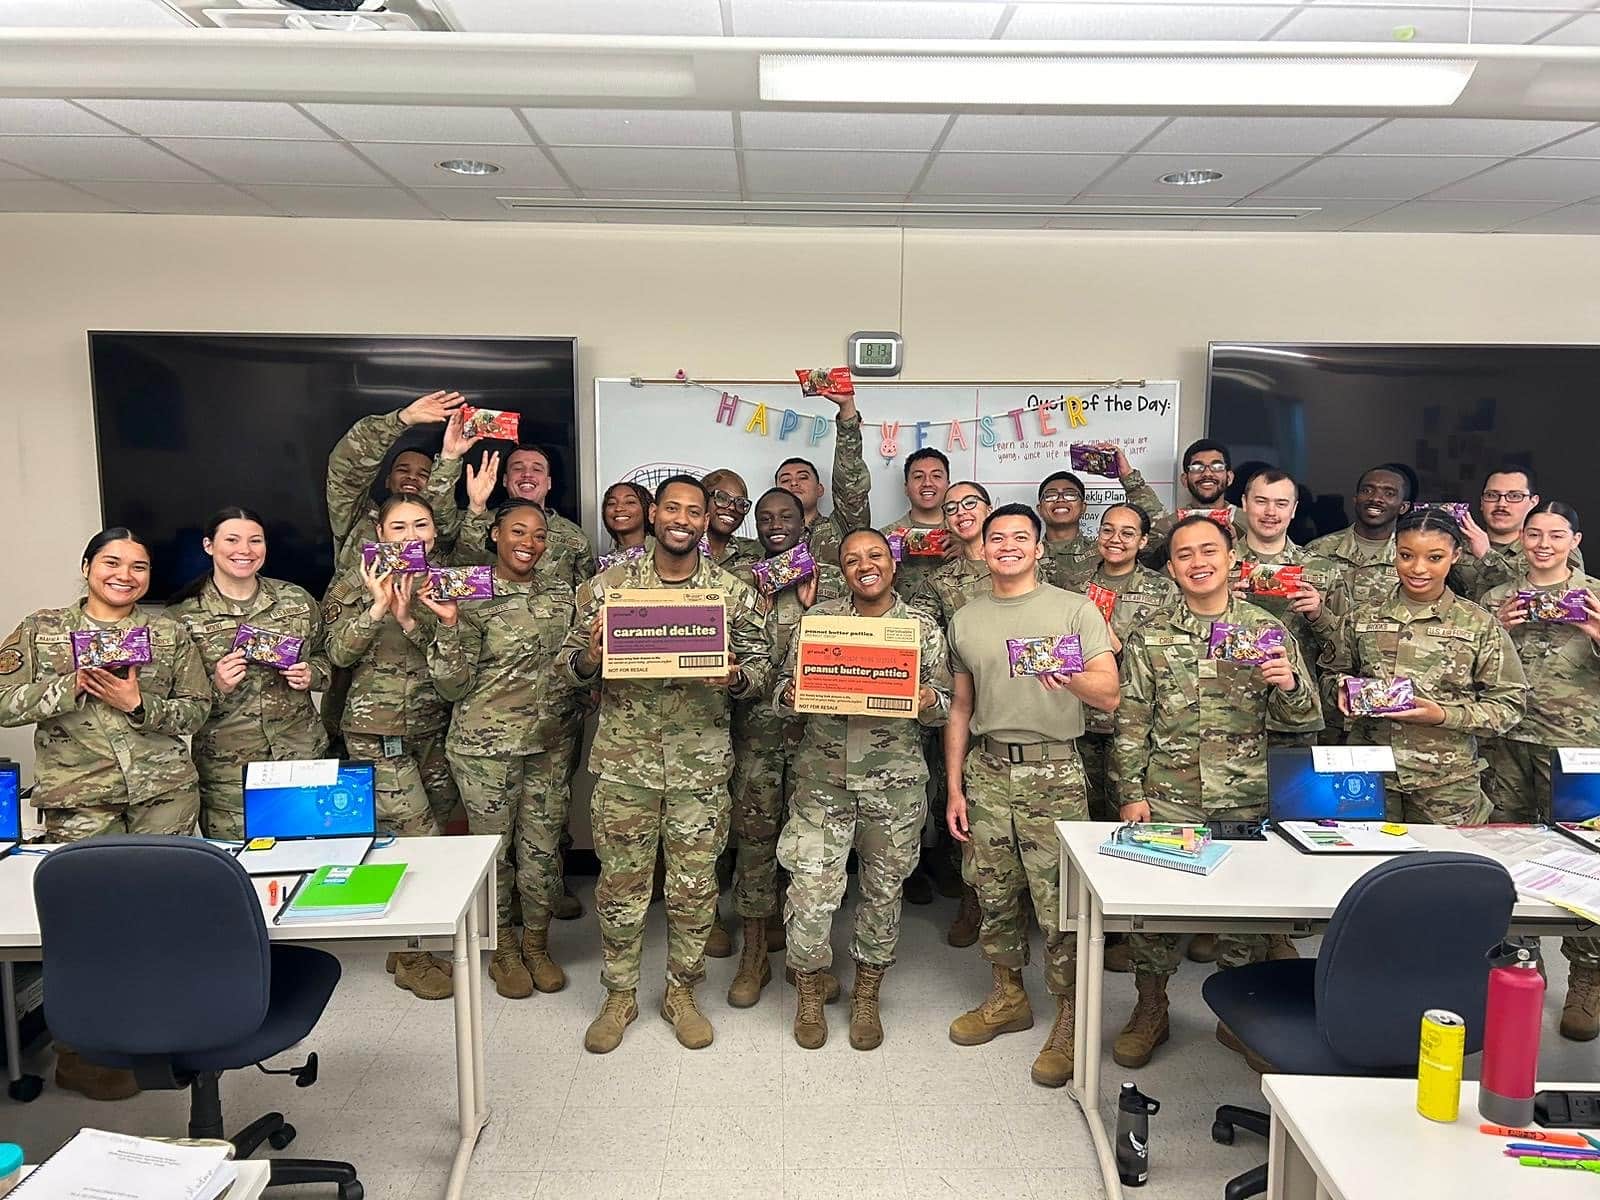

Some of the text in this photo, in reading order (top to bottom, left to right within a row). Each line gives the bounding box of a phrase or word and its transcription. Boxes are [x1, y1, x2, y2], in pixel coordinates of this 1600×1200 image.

[1081, 393, 1100, 412] of
[1104, 393, 1133, 412] the
[1137, 395, 1171, 416] Day:
[716, 391, 864, 446] HAPP
[993, 440, 1015, 452] Learn
[1019, 440, 1029, 449] as
[1033, 438, 1054, 449] much
[1058, 440, 1068, 448] as
[1123, 436, 1135, 447] you
[1085, 490, 1103, 503] ekly
[613, 624, 717, 638] caramel deLites
[803, 664, 908, 679] peanut butter patties
